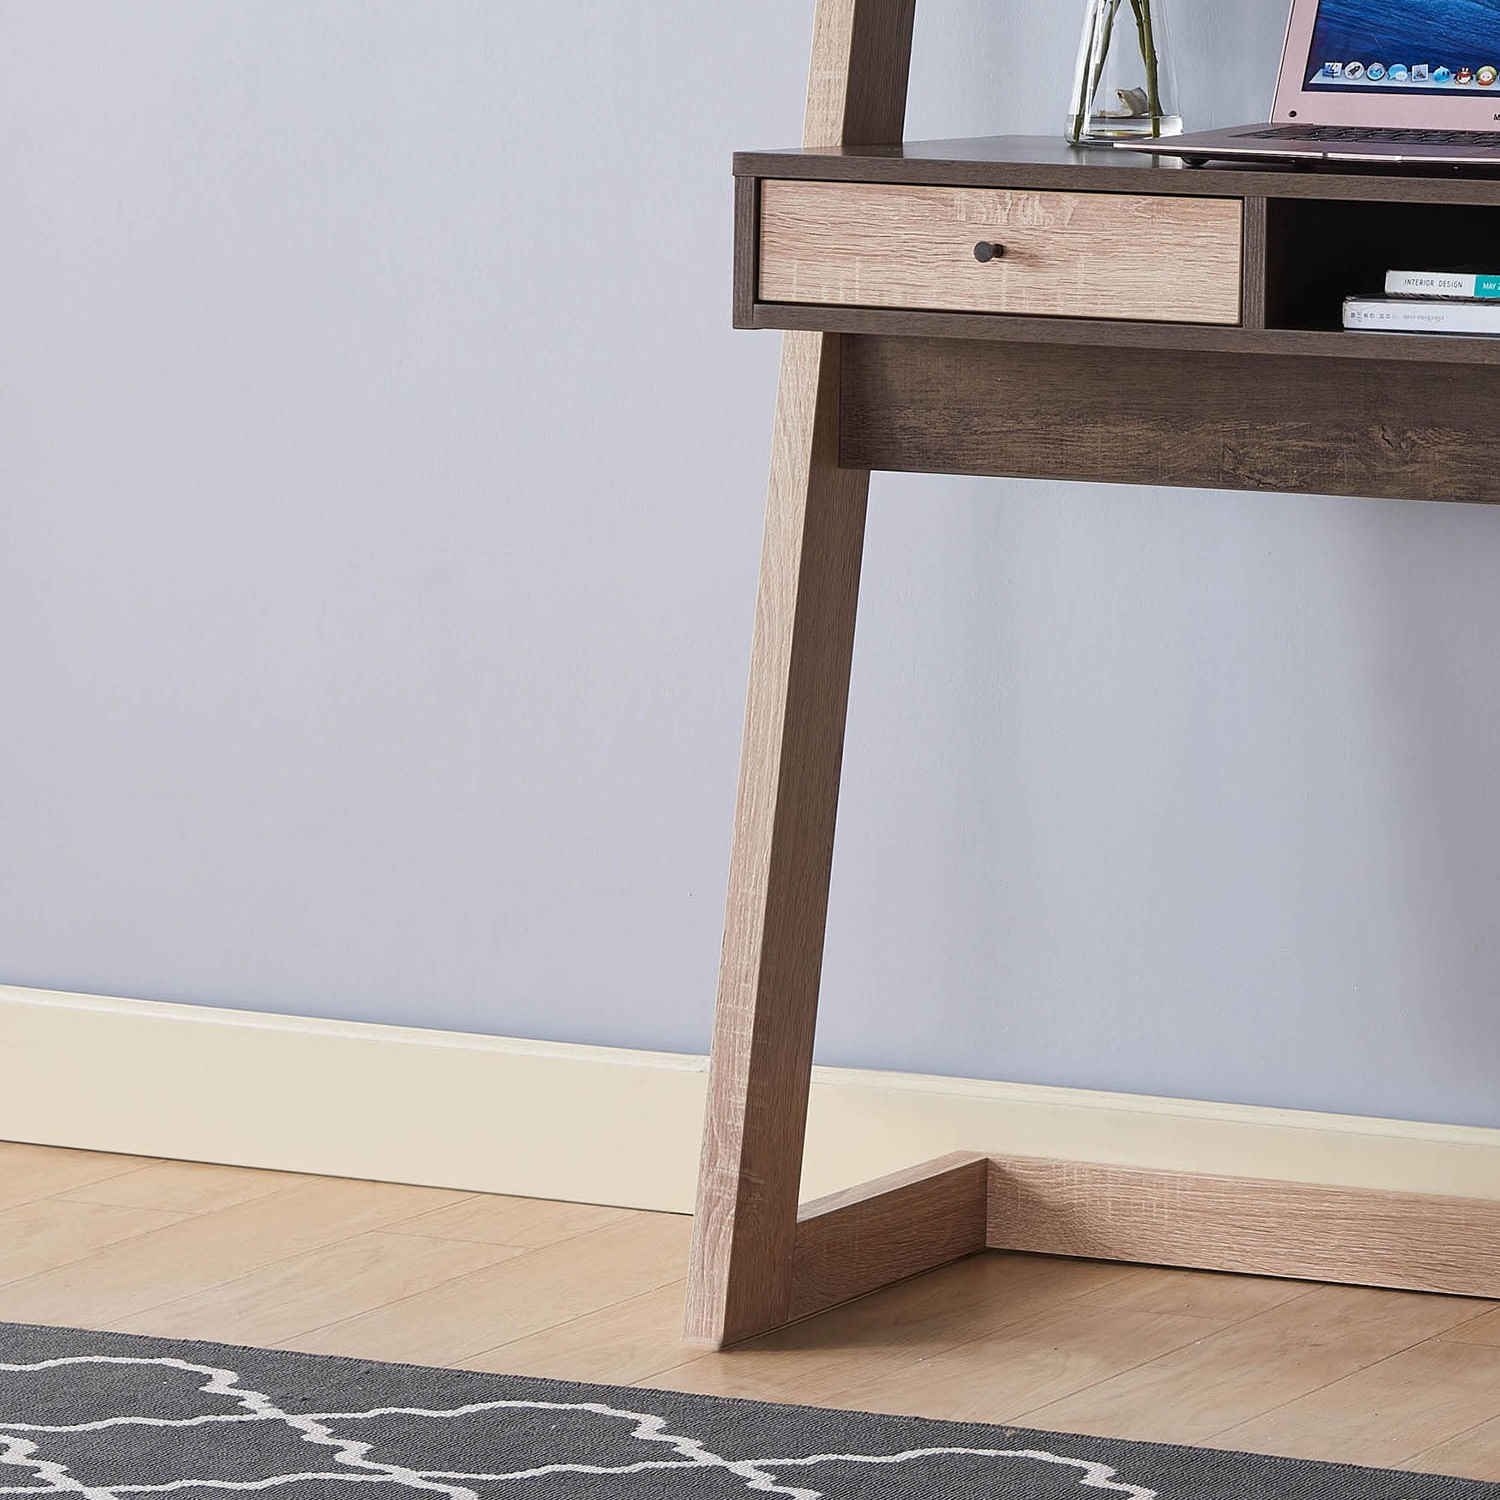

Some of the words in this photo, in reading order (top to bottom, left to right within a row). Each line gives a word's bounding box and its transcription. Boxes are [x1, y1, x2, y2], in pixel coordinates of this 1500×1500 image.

[1404, 278, 1435, 287] INTERIOR
[1438, 280, 1464, 289] DESIGN
[1482, 282, 1496, 290] MAY
